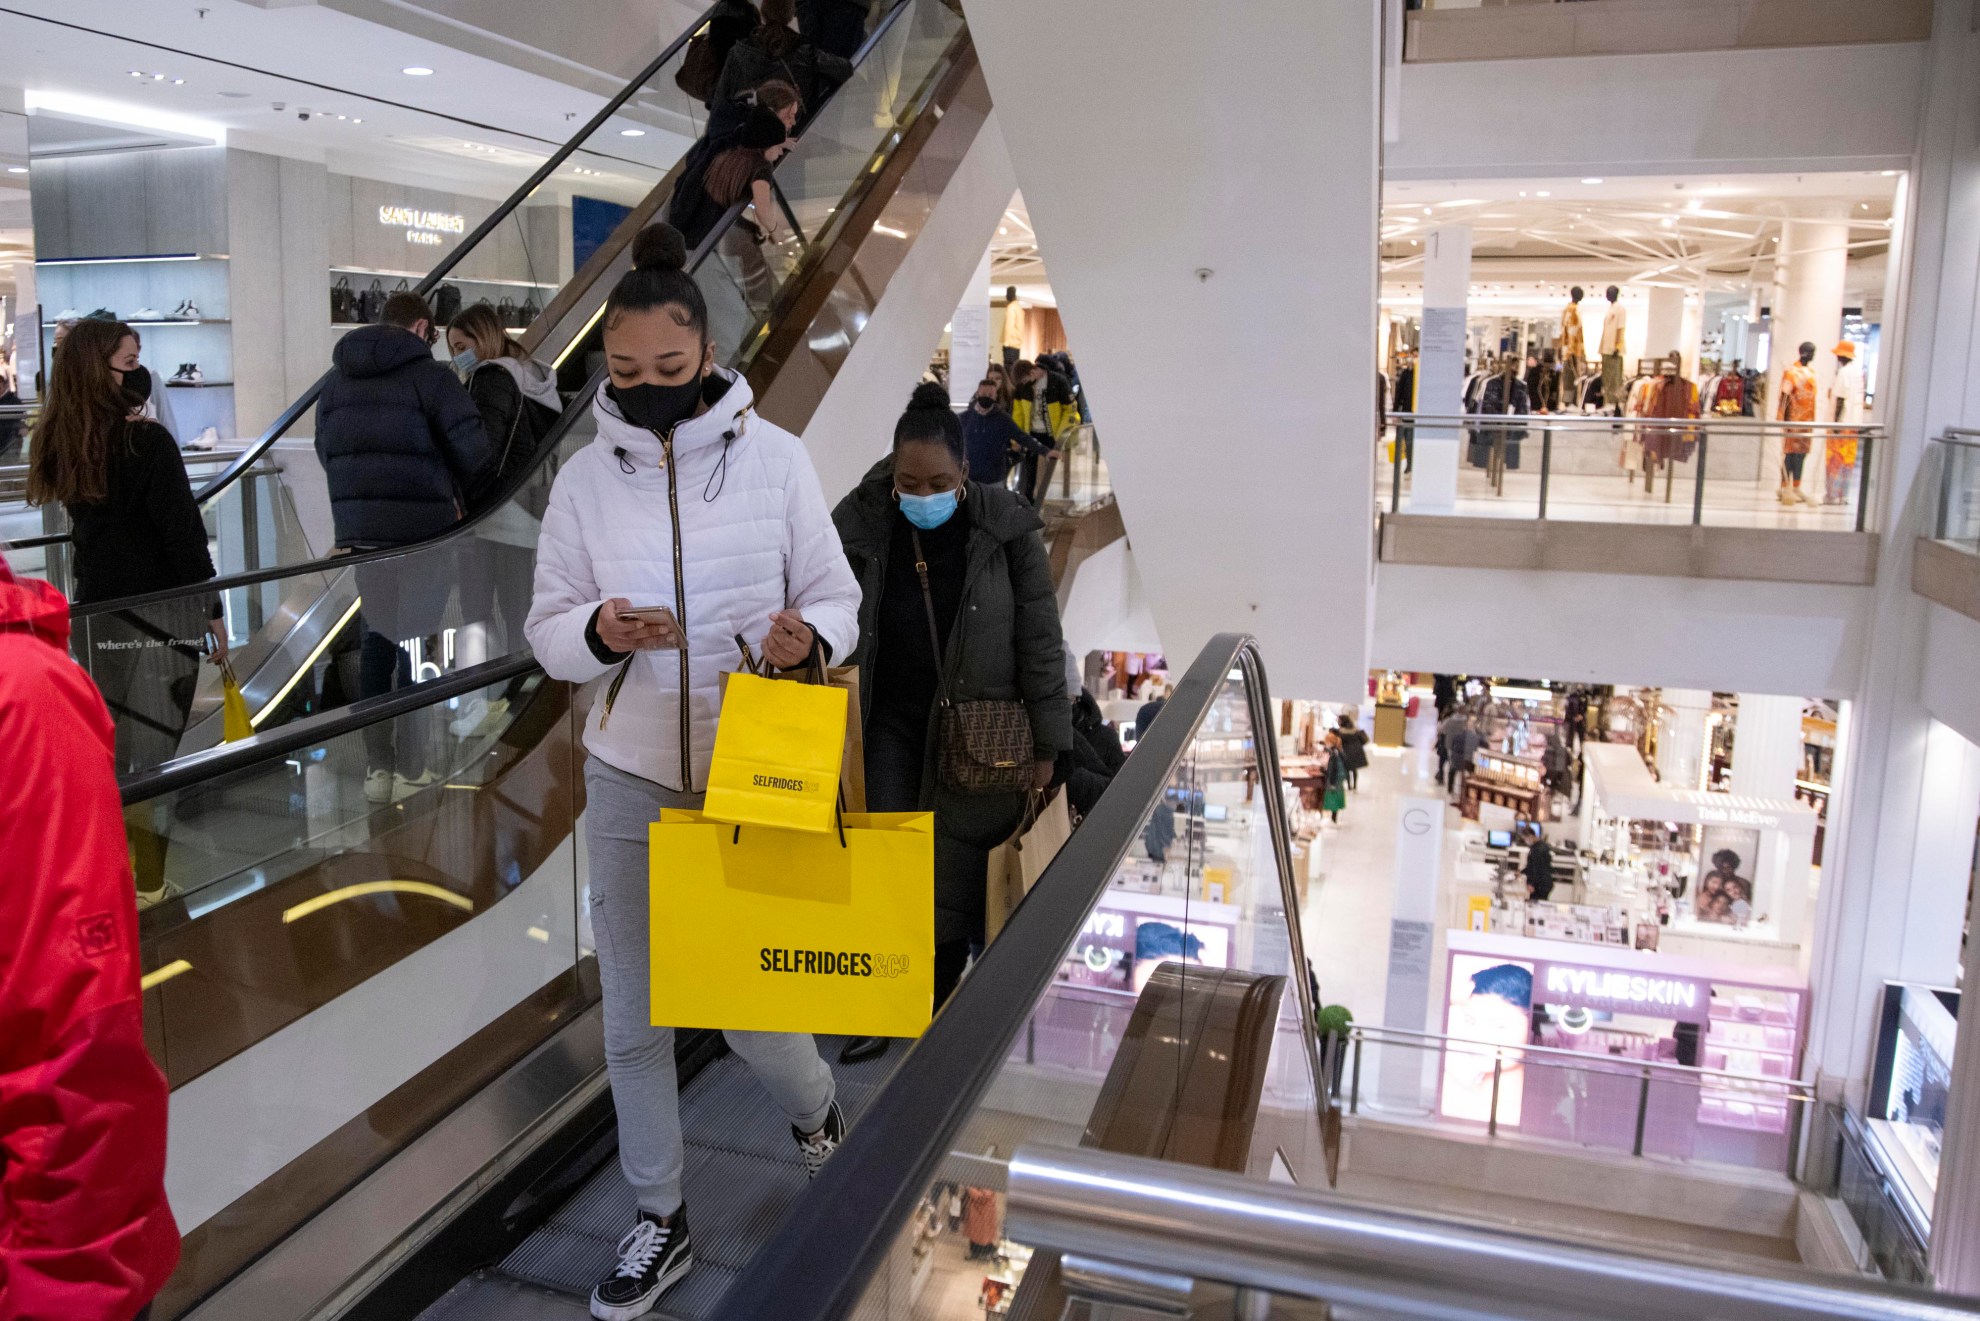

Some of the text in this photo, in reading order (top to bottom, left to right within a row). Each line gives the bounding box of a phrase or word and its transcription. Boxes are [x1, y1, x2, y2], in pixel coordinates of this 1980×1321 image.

[97, 640, 142, 650] where's
[145, 639, 164, 648] the
[1403, 808, 1431, 836] G
